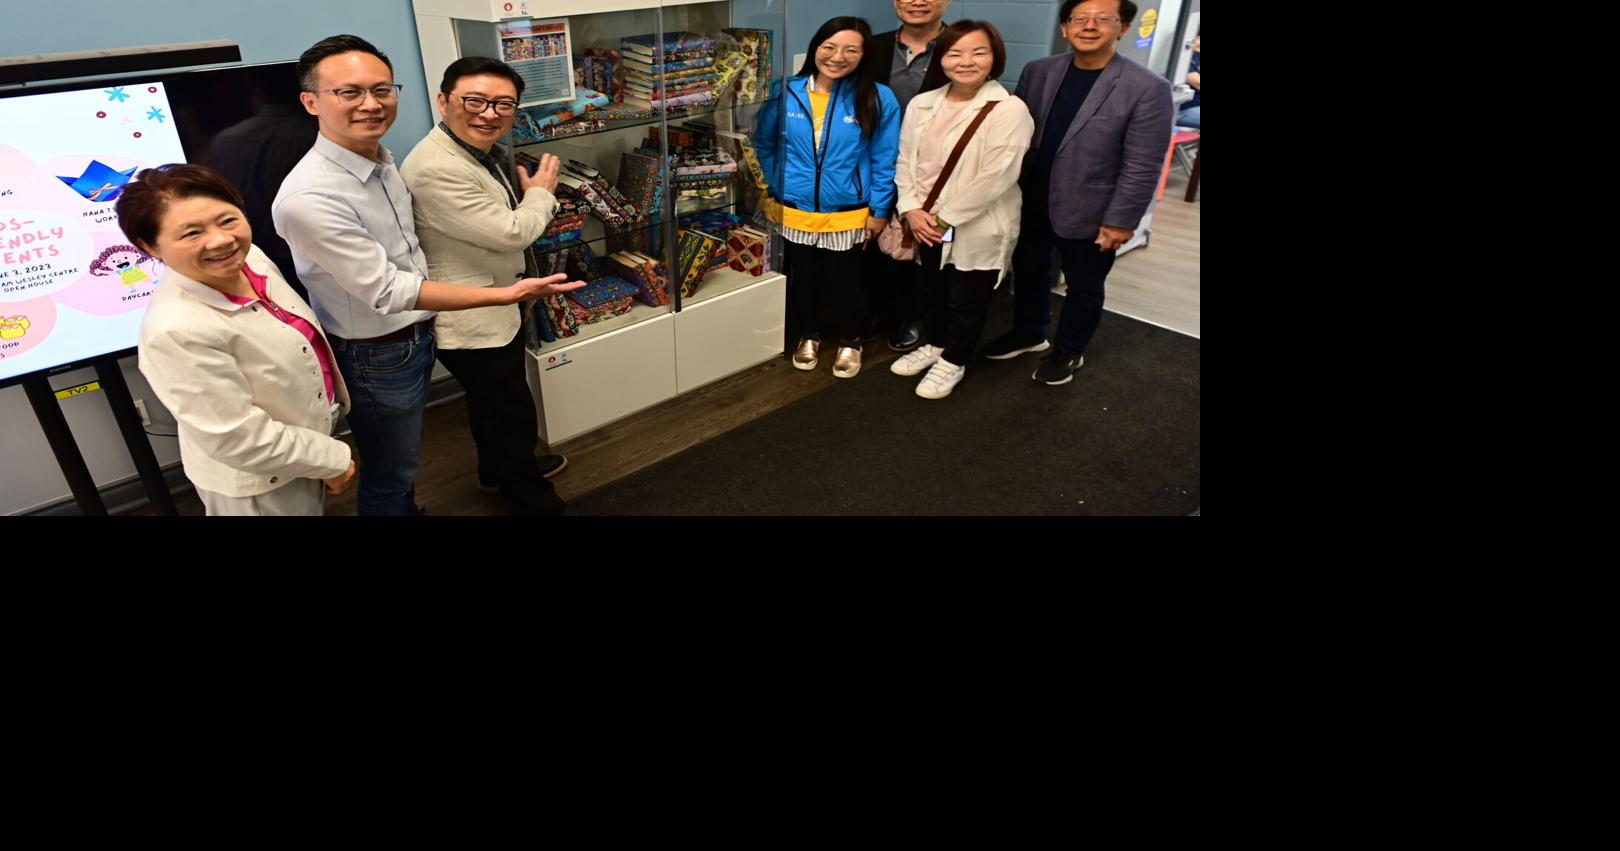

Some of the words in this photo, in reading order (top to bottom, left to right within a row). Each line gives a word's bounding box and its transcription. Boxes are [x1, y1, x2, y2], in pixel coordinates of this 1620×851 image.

[83, 209, 105, 217] HANA
[25, 263, 51, 273] 2023
[15, 274, 46, 284] WESLEY
[48, 268, 78, 277] CENTRE
[28, 279, 53, 288] HOUSE
[67, 385, 89, 395] TV2
